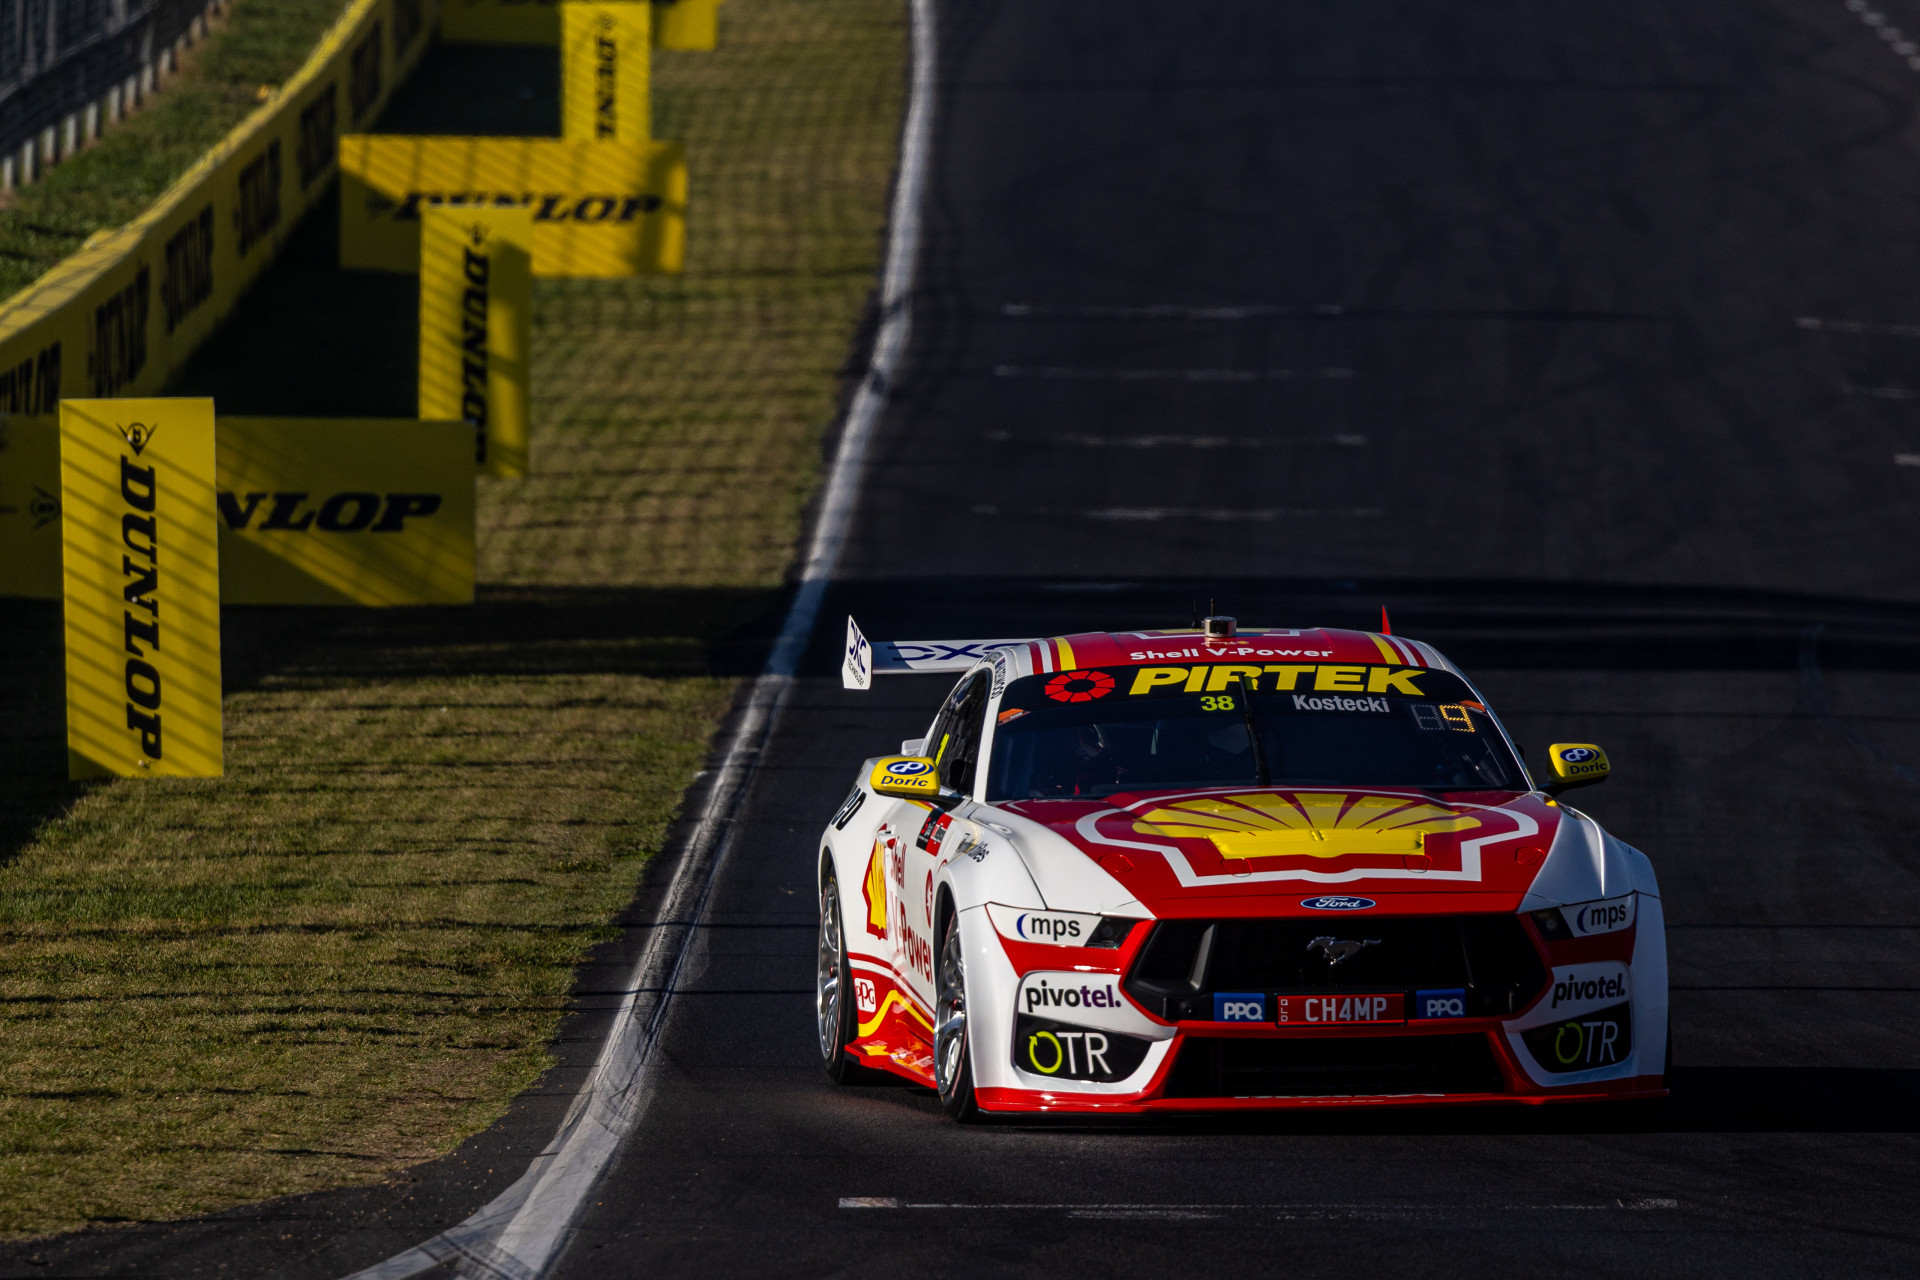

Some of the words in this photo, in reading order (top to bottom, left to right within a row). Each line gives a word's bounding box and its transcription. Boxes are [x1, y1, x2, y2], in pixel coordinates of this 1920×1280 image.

[217, 492, 442, 534] NLOP
[120, 454, 162, 760] DUNLOP
[1129, 648, 1199, 660] Shell
[1206, 647, 1334, 658] V-Power
[1128, 665, 1427, 697] PIRTEK
[1199, 695, 1236, 712] 38
[1292, 695, 1391, 713] Kostecki
[881, 775, 929, 787] Doric
[1569, 762, 1608, 775] Doric
[1315, 897, 1361, 908] Ford
[1031, 916, 1081, 942] mps
[1591, 904, 1626, 930] mps
[855, 981, 876, 1008] PPG
[1025, 979, 1122, 1013] pivotel.
[1551, 973, 1626, 1009] pivotel.
[1223, 1002, 1263, 1020] PPQ
[1304, 996, 1388, 1022] CH4MP
[1426, 998, 1464, 1017] PPQ
[1028, 1030, 1113, 1075] OTR
[1555, 1020, 1619, 1065] OTR
